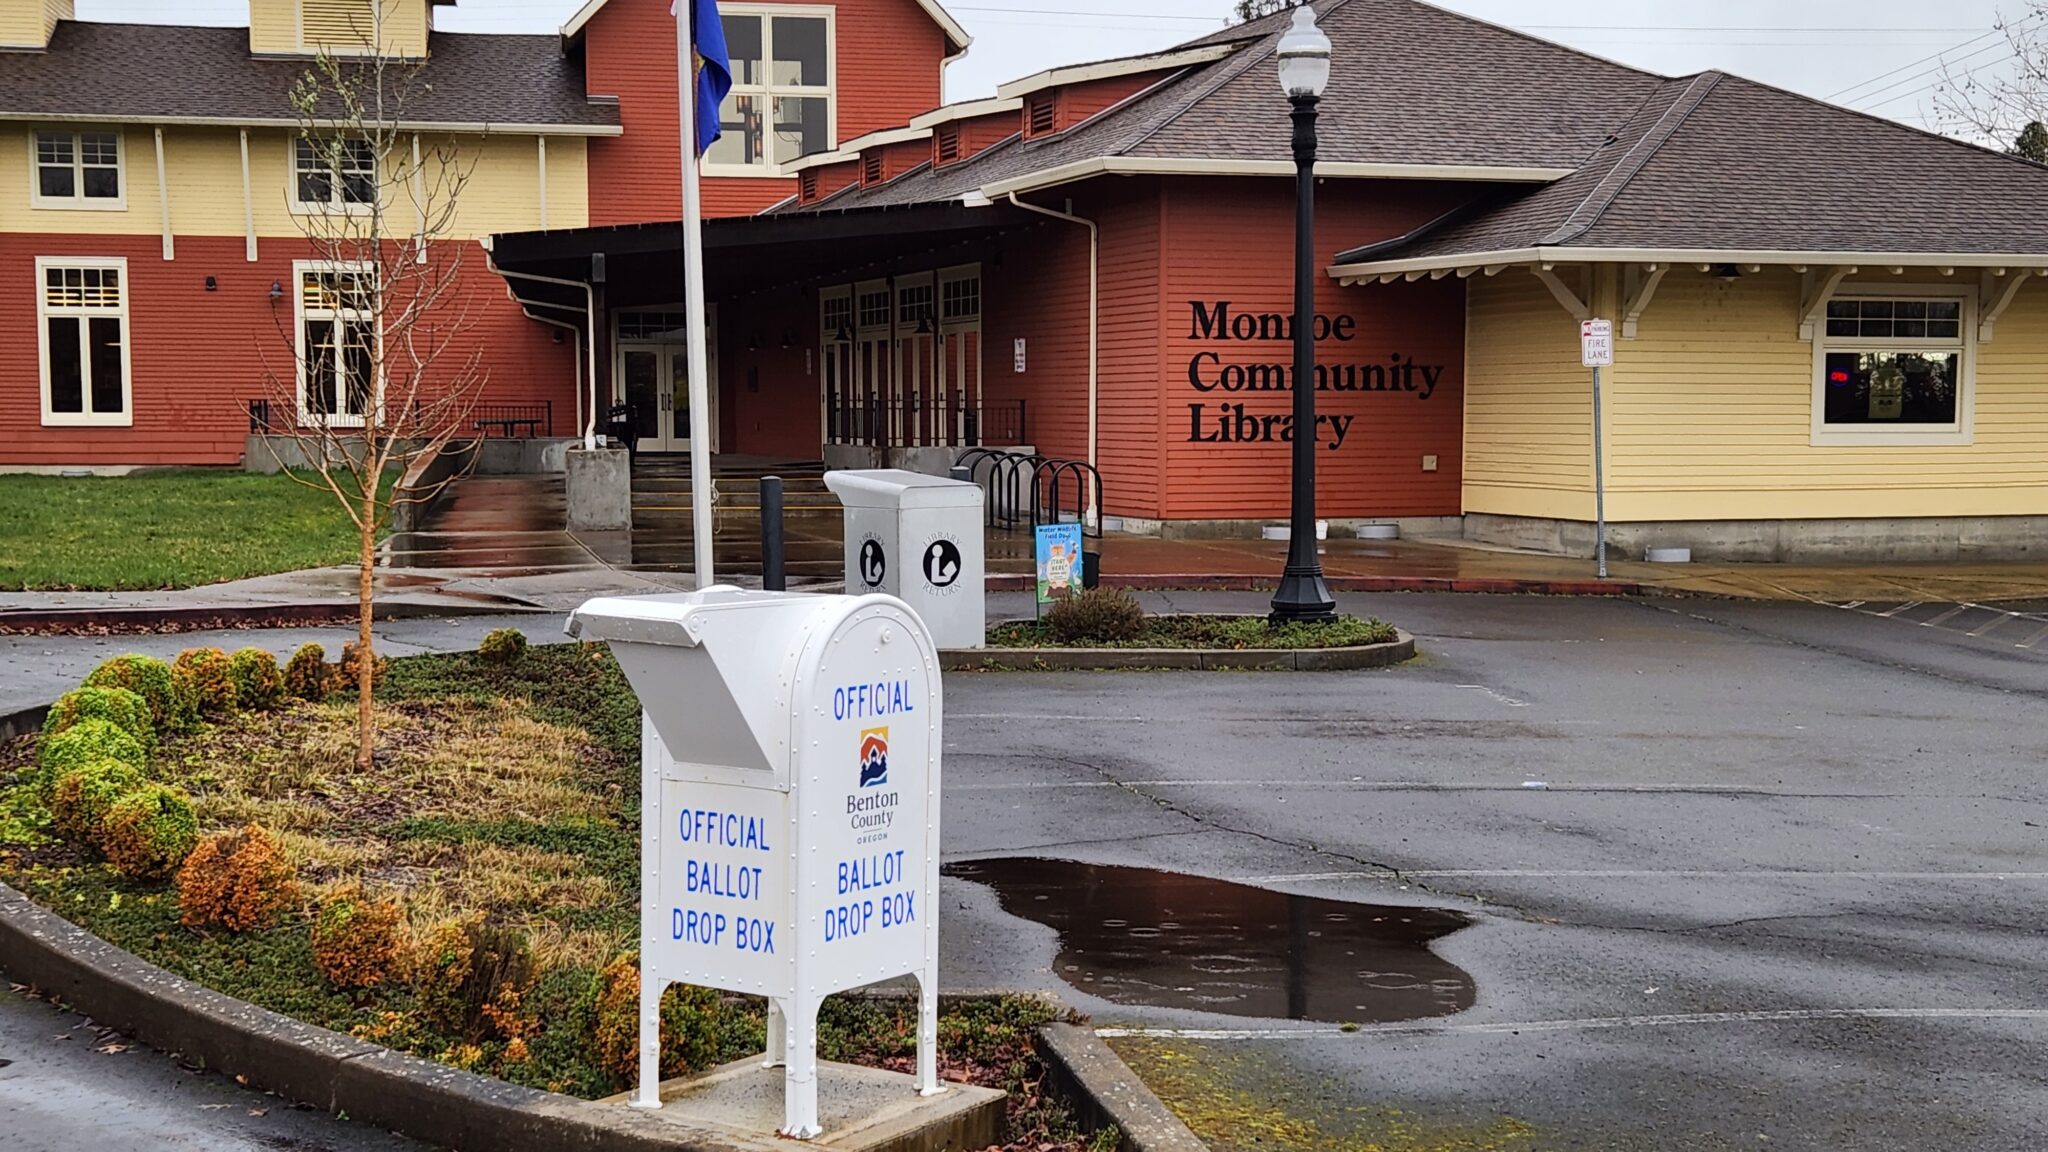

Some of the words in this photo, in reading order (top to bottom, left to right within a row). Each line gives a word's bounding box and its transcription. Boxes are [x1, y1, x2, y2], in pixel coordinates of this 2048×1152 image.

[1187, 300, 1355, 341] Monoe
[1588, 339, 1606, 348] FIRE
[1588, 351, 1608, 359] LANE
[859, 531, 885, 546] LIBRARY
[923, 531, 962, 547] LIBRARY
[922, 581, 962, 597] RETURN
[834, 680, 913, 720] OFFICIAL
[847, 790, 899, 814] Benton
[680, 809, 770, 851] OFFICIAL
[851, 810, 894, 830] County
[857, 832, 888, 845] OREGON
[687, 860, 762, 901] BALLOT
[838, 850, 904, 895] BALLOT
[825, 900, 873, 942] DROP
[882, 890, 915, 928] BOX
[672, 908, 726, 946] DROP
[736, 917, 775, 954] BOX
